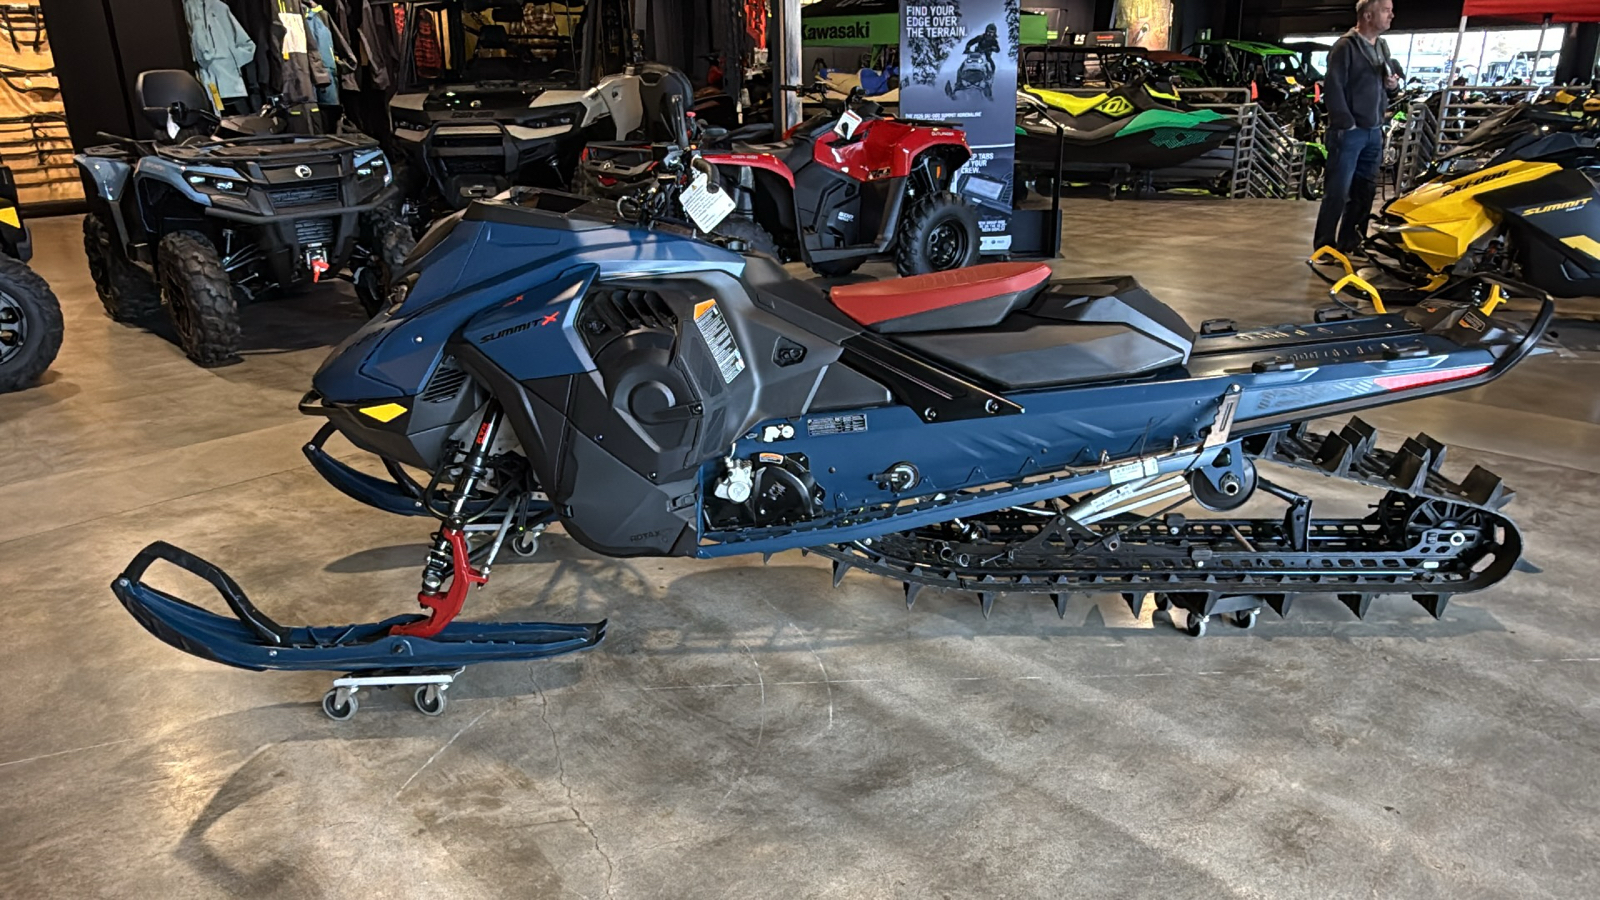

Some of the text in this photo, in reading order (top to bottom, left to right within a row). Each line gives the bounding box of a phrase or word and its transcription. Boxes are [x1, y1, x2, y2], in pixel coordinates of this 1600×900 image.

[906, 5, 955, 16] FIND YOUR
[906, 16, 958, 27] EDGE OVER
[802, 21, 870, 40] Kawasaki
[905, 26, 968, 38] THE TERRAIN.
[979, 152, 994, 160] TABS
[971, 159, 987, 168] YOUR
[1521, 197, 1593, 217] SUMMIT
[480, 318, 543, 344] SUMMIT
